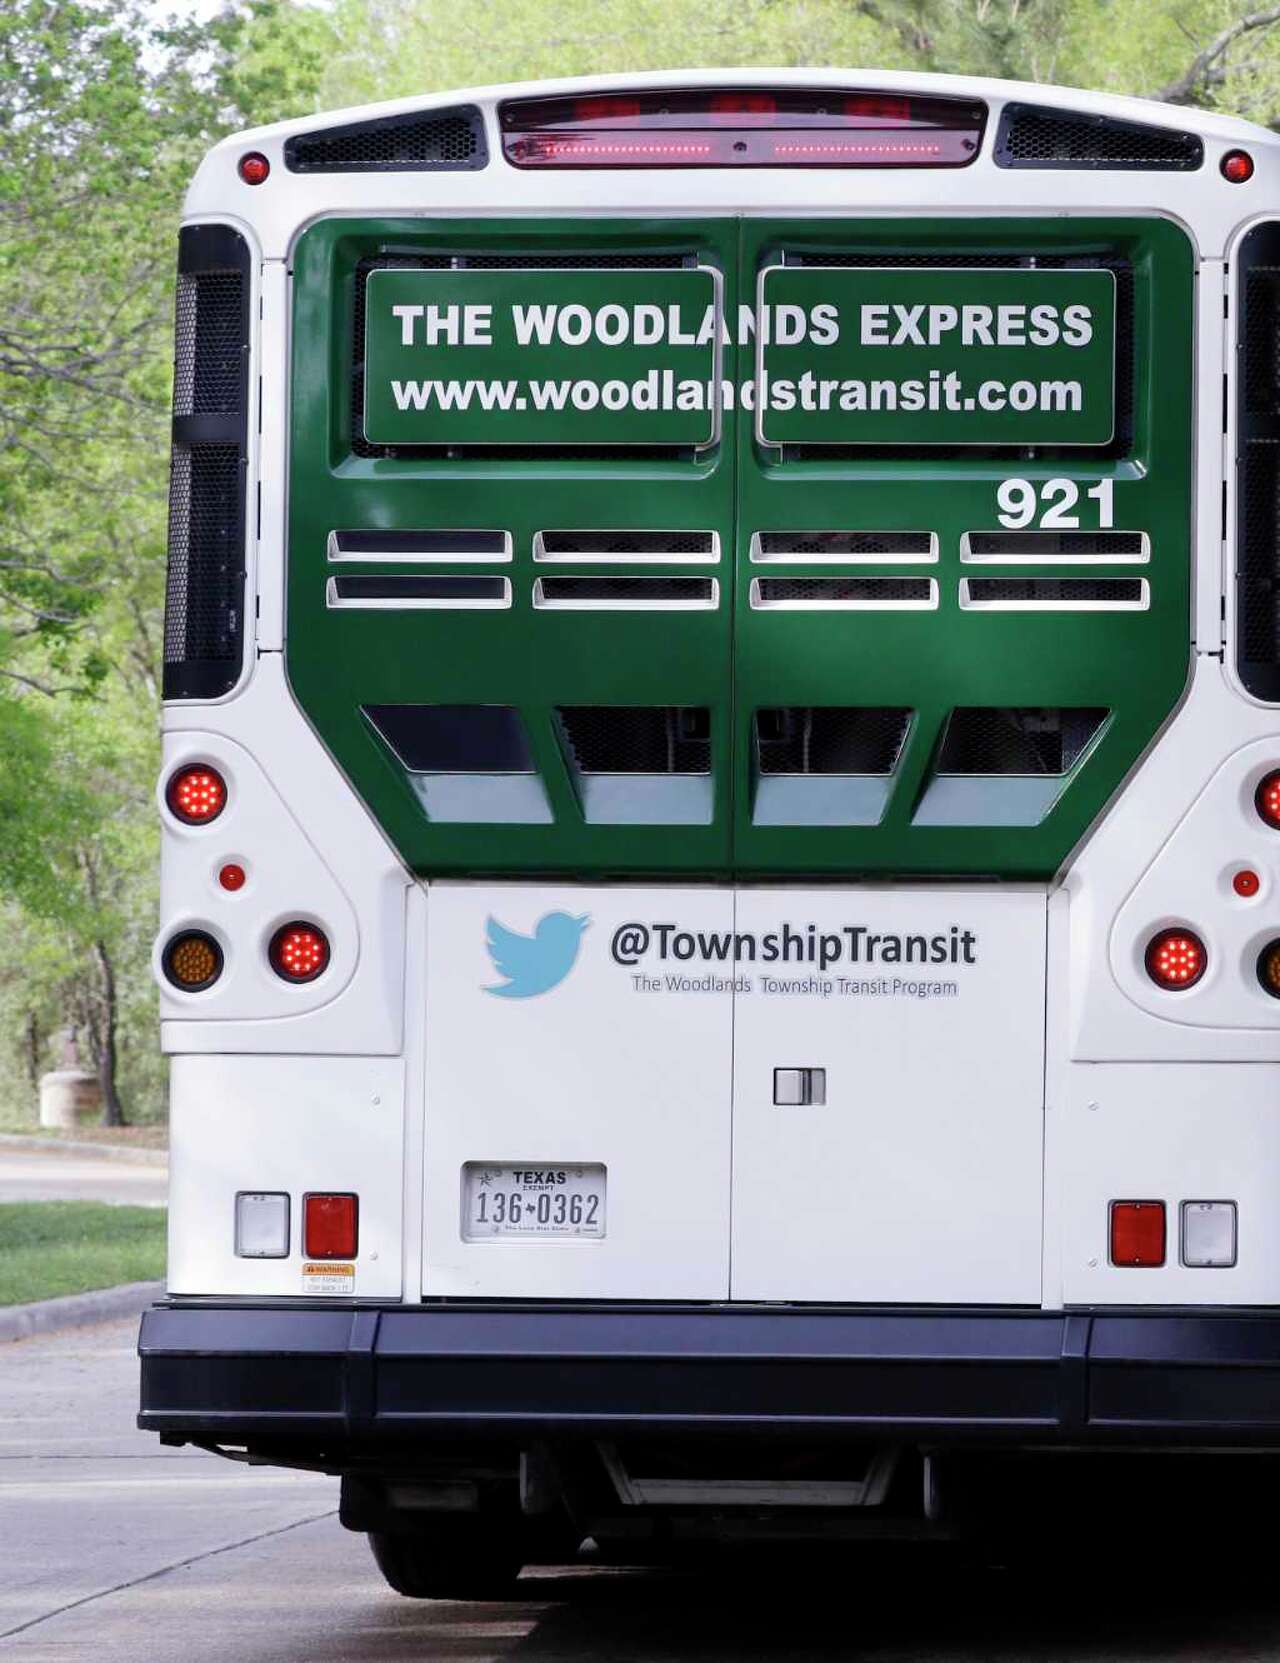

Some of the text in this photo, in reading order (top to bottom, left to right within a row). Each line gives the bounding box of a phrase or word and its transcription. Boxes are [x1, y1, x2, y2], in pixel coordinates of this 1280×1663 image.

[393, 304, 1093, 346] THE WOODLANDS EXPRESS
[391, 368, 1082, 412] www.woodlandstransit.com
[997, 478, 1113, 529] 921
[611, 923, 976, 970] @TownshipTransit
[632, 975, 958, 999] The Woodlands Township Transit Program
[513, 1171, 567, 1185] TEXAS
